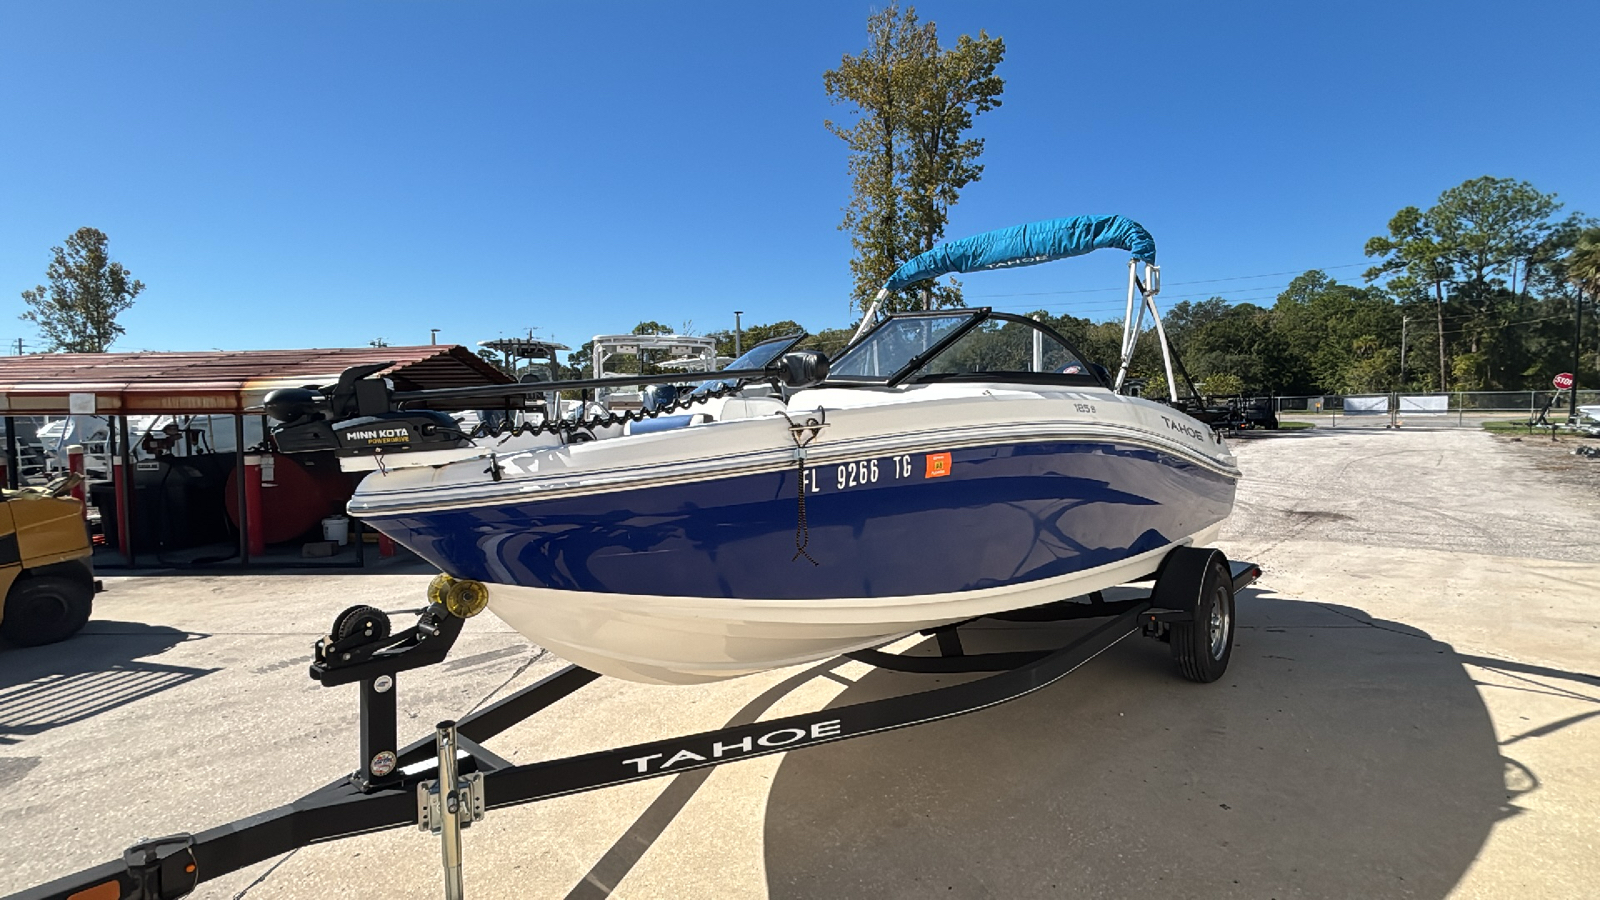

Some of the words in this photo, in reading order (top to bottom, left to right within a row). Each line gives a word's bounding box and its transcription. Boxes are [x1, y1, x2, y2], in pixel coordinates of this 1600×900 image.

[985, 254, 1048, 268] TAHOE
[1073, 403, 1090, 413] 185
[346, 430, 377, 441] MINN
[379, 428, 409, 438] KOTA
[1161, 415, 1204, 442] TAHOE
[367, 436, 410, 445] POWERDRIVE
[802, 468, 820, 493] FL
[837, 459, 879, 490] 9266
[892, 454, 912, 479] TG
[622, 719, 841, 773] TAHOE
